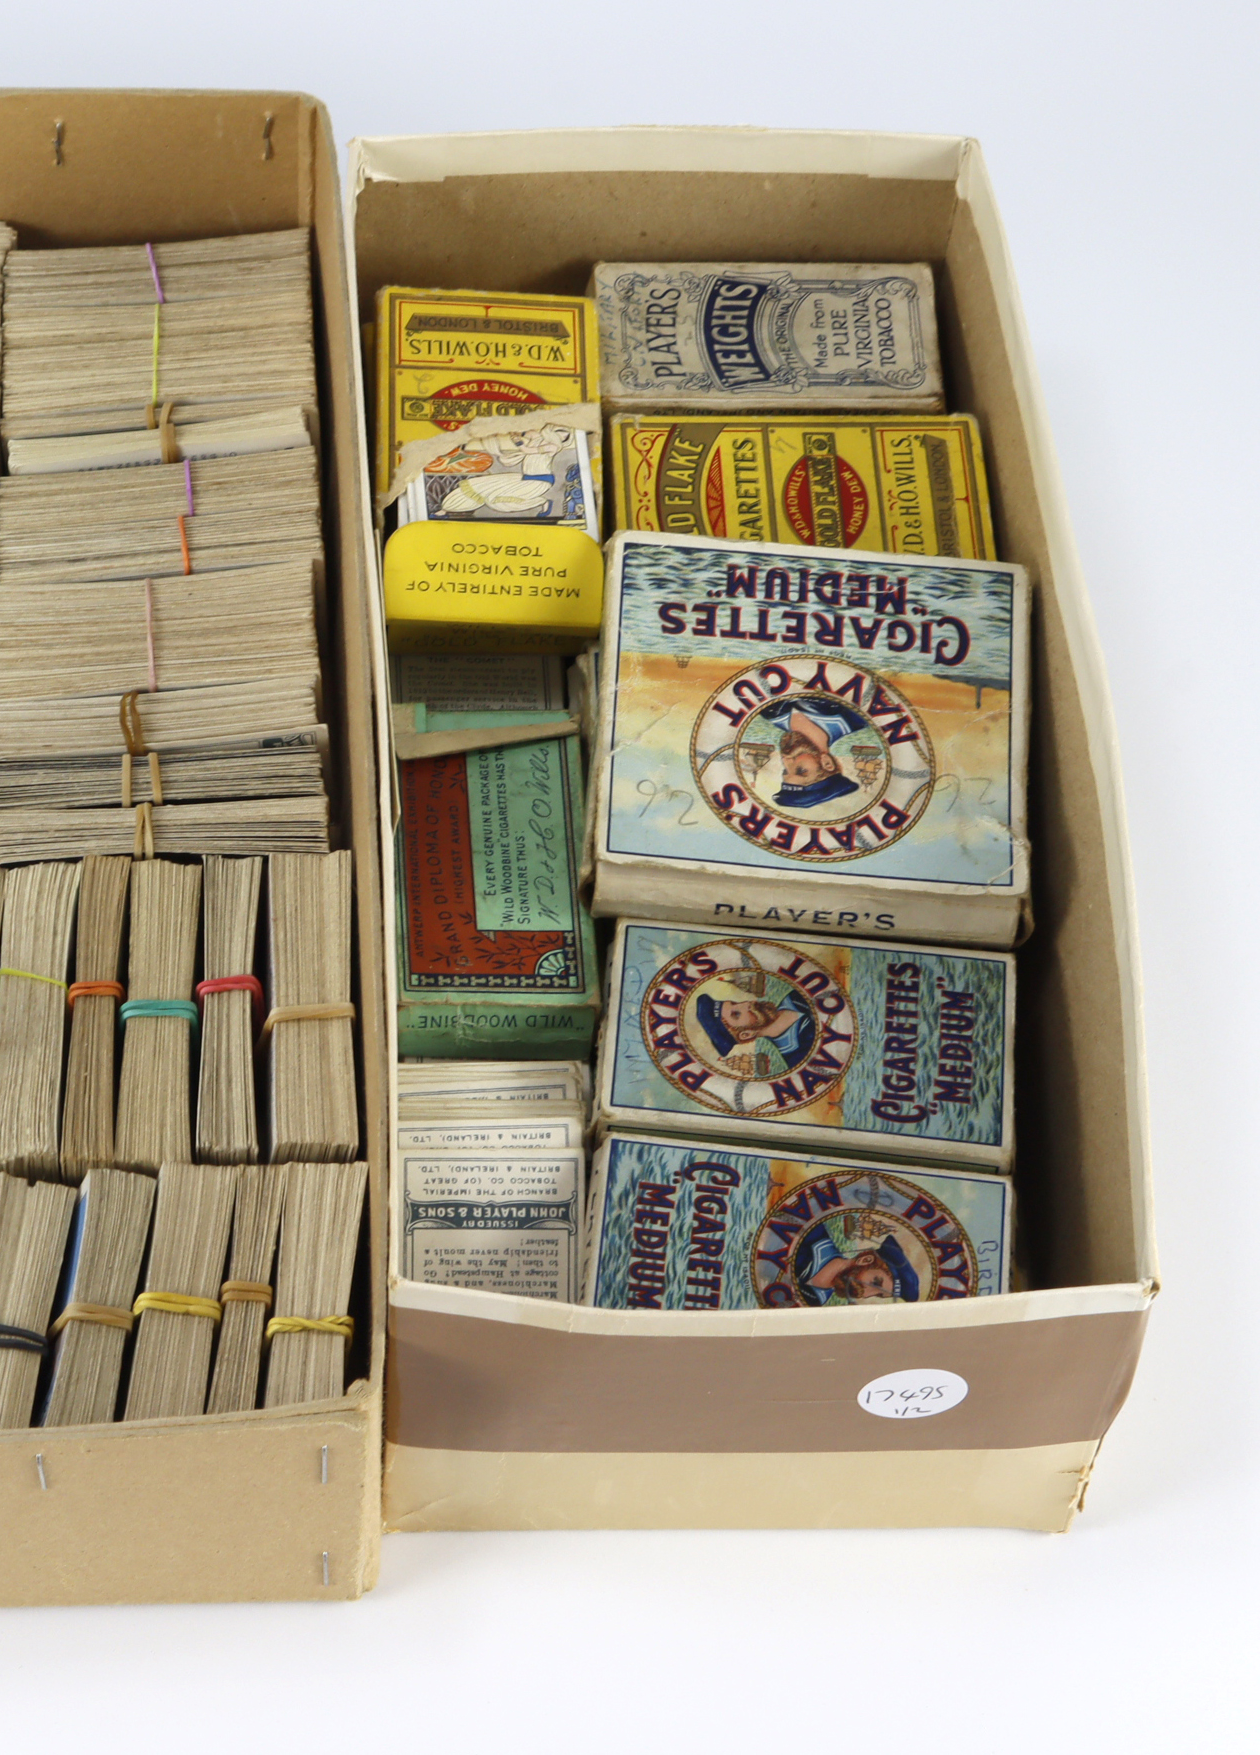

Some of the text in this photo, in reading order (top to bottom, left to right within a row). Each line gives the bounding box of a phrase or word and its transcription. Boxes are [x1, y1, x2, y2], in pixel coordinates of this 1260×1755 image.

[483, 319, 491, 330] &
[499, 319, 559, 333] BRISTOL
[645, 288, 686, 378] PLAYER'S
[775, 300, 798, 366] THE ORIGINAL
[810, 299, 828, 368] Made from
[831, 309, 850, 357] PURE
[852, 298, 872, 369] VIRGINIA
[875, 298, 896, 367] TOBACCO
[482, 383, 529, 400] HONEY
[432, 400, 493, 418] FLAKE
[732, 437, 764, 542] GARETTES
[846, 497, 865, 535] HONEY
[814, 507, 841, 547] GOLD
[451, 542, 544, 558] TOBACCO
[423, 560, 568, 579] PURE VIRGINIA
[404, 579, 582, 598] MADE ENTIRELY OF
[706, 563, 929, 617] "MEDIUM"
[657, 601, 971, 667] CIGARETTES
[712, 660, 921, 747] NAVY CUT
[494, 763, 506, 780] HAS
[426, 803, 439, 825] OF
[712, 782, 912, 858] PLAYER'S
[478, 762, 497, 896] EVERY GENUINE PACKAGE
[425, 830, 449, 905] DIPLOMA
[516, 866, 531, 924] SIGNATURE
[714, 903, 897, 931] PLAYER'S
[438, 911, 469, 967] GRAND
[648, 950, 719, 1093] PLAYER'S
[771, 954, 855, 1111] NAVY CUT
[870, 961, 930, 1125] CIGARETTES
[926, 976, 976, 1118] "MEDIUM"
[511, 1132, 552, 1140] BRITAIN
[510, 1177, 557, 1185] TOBACCO
[422, 1188, 472, 1196] IMPERIAL
[476, 1188, 497, 1196] THE
[516, 1188, 558, 1196] BRANCH
[457, 1206, 468, 1218] &
[473, 1206, 527, 1218] PLAYER
[529, 1206, 566, 1218] JOHN
[755, 1178, 845, 1265] NAVY
[461, 1219, 519, 1228] ISSUED BY
[682, 1161, 742, 1309] CIGARETT
[433, 1248, 466, 1256] moult
[469, 1248, 499, 1256] never
[503, 1247, 560, 1258] friendship
[422, 1259, 434, 1268] of
[439, 1258, 462, 1268] wing
[467, 1259, 483, 1268] the
[488, 1258, 508, 1268] May
[548, 1260, 560, 1268] to
[423, 1269, 438, 1278] Go
[509, 1270, 521, 1278] at
[524, 1268, 559, 1278] cottage
[464, 1279, 485, 1288] and
[865, 1385, 949, 1404] 17495
